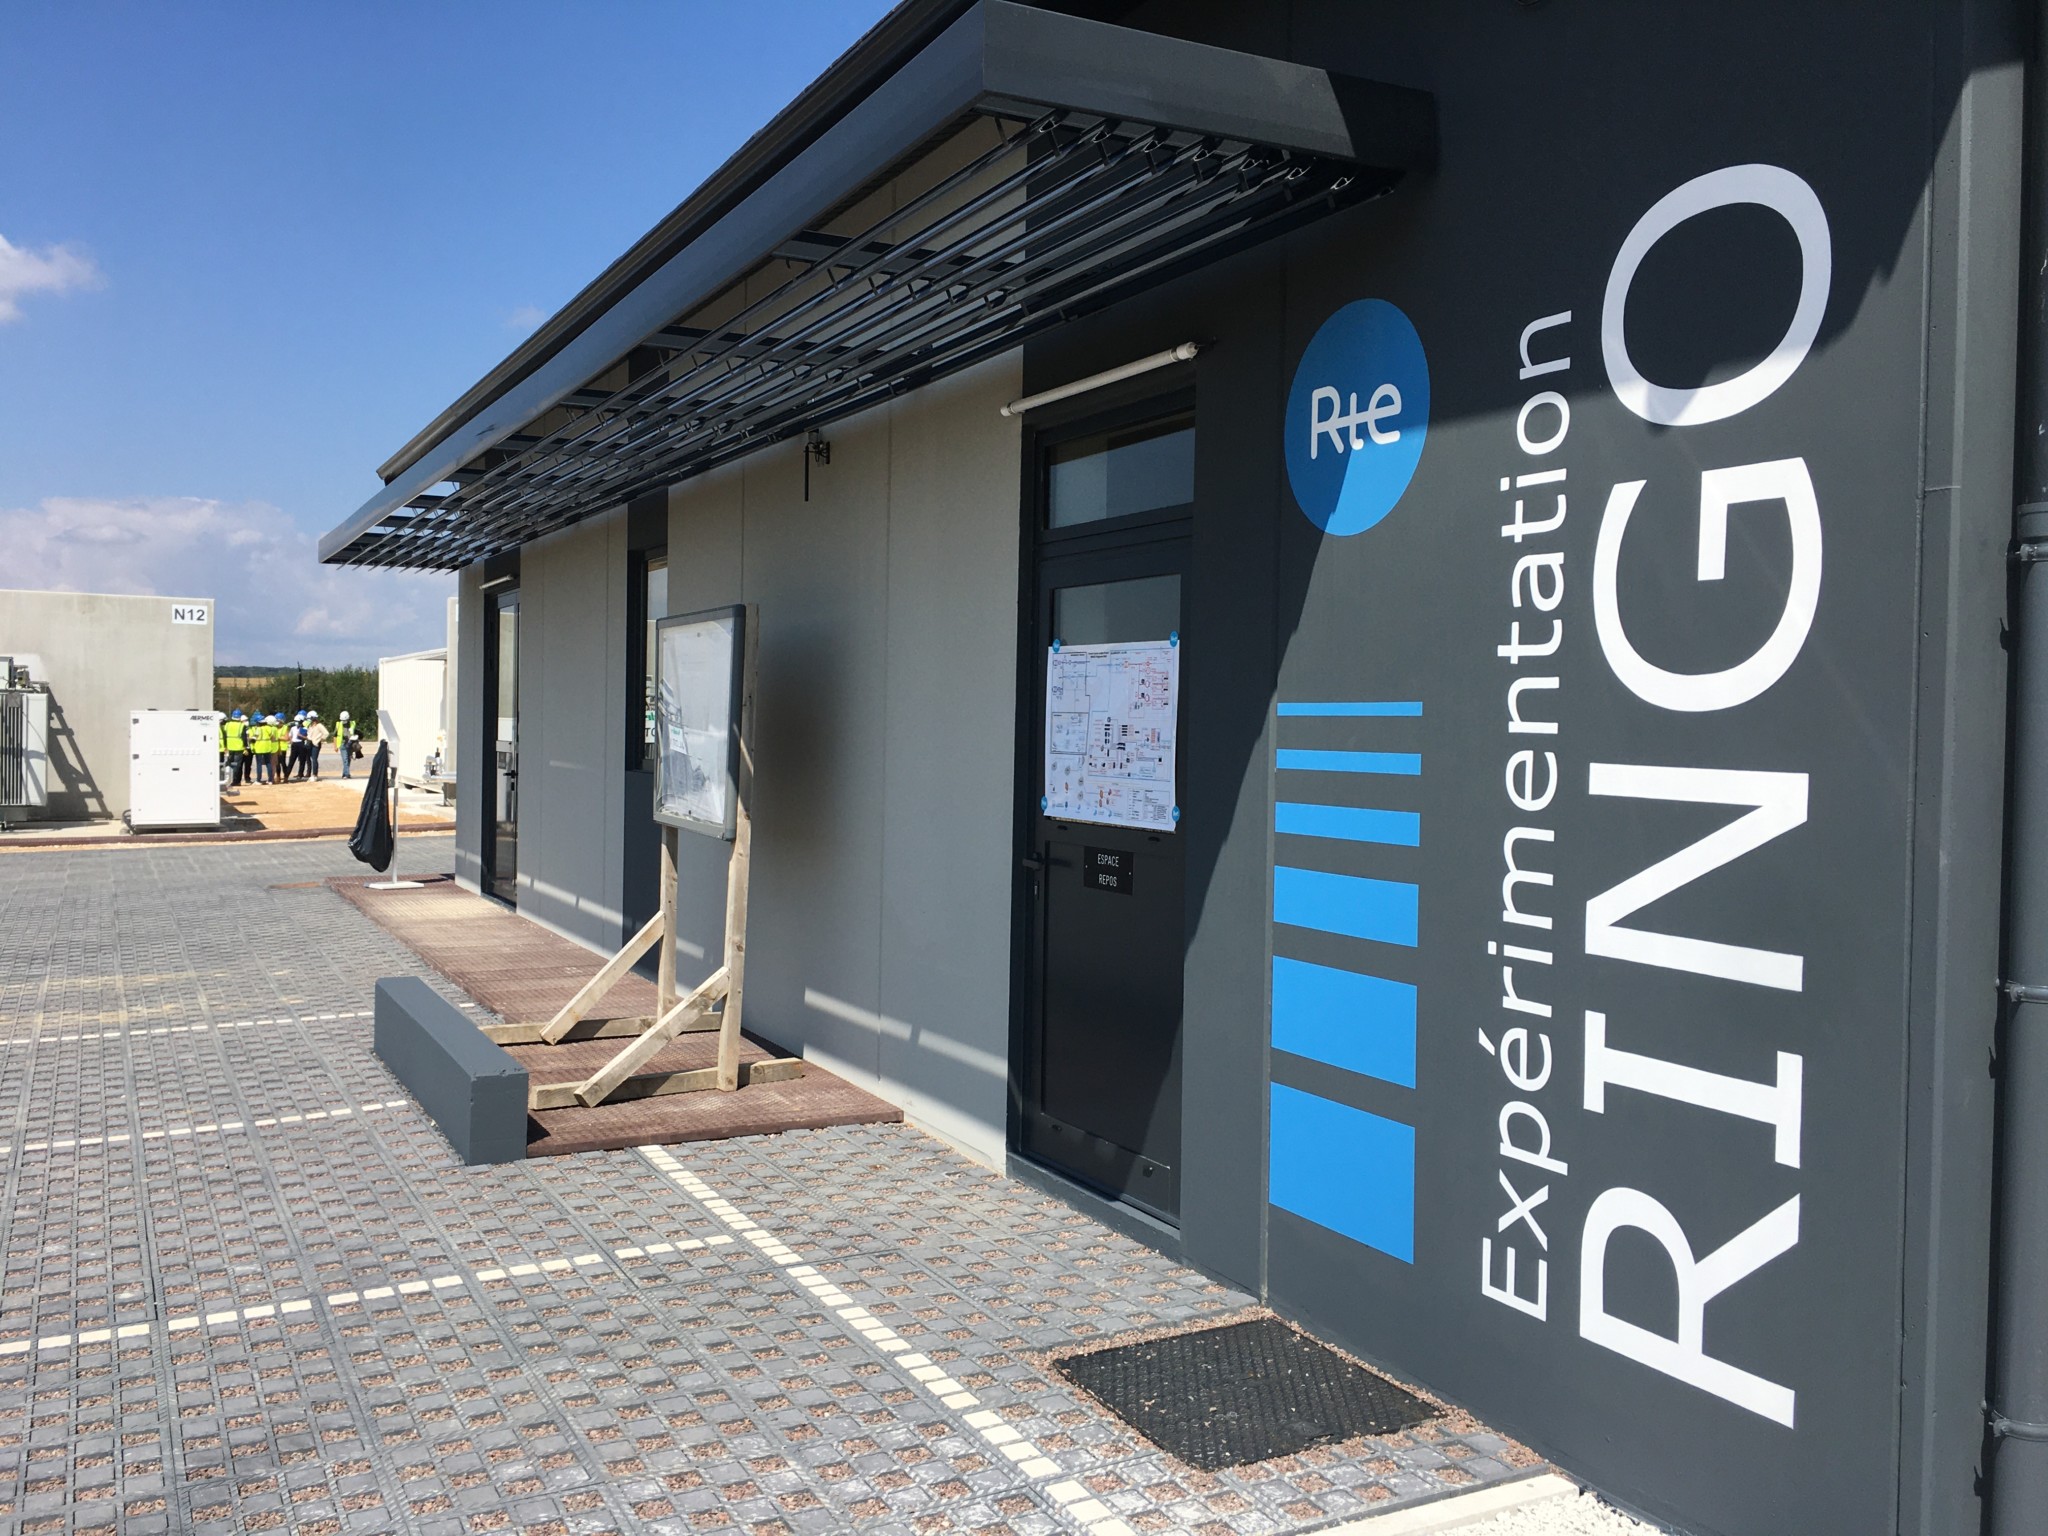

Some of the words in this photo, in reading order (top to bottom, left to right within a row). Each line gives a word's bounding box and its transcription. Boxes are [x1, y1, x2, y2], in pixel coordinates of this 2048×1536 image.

[174, 608, 205, 621] N12
[1578, 163, 1833, 1430] RINGO
[1478, 310, 1573, 1323] Expérimentation
[1097, 853, 1119, 867] ESPACE
[1098, 873, 1118, 887] REPOS
